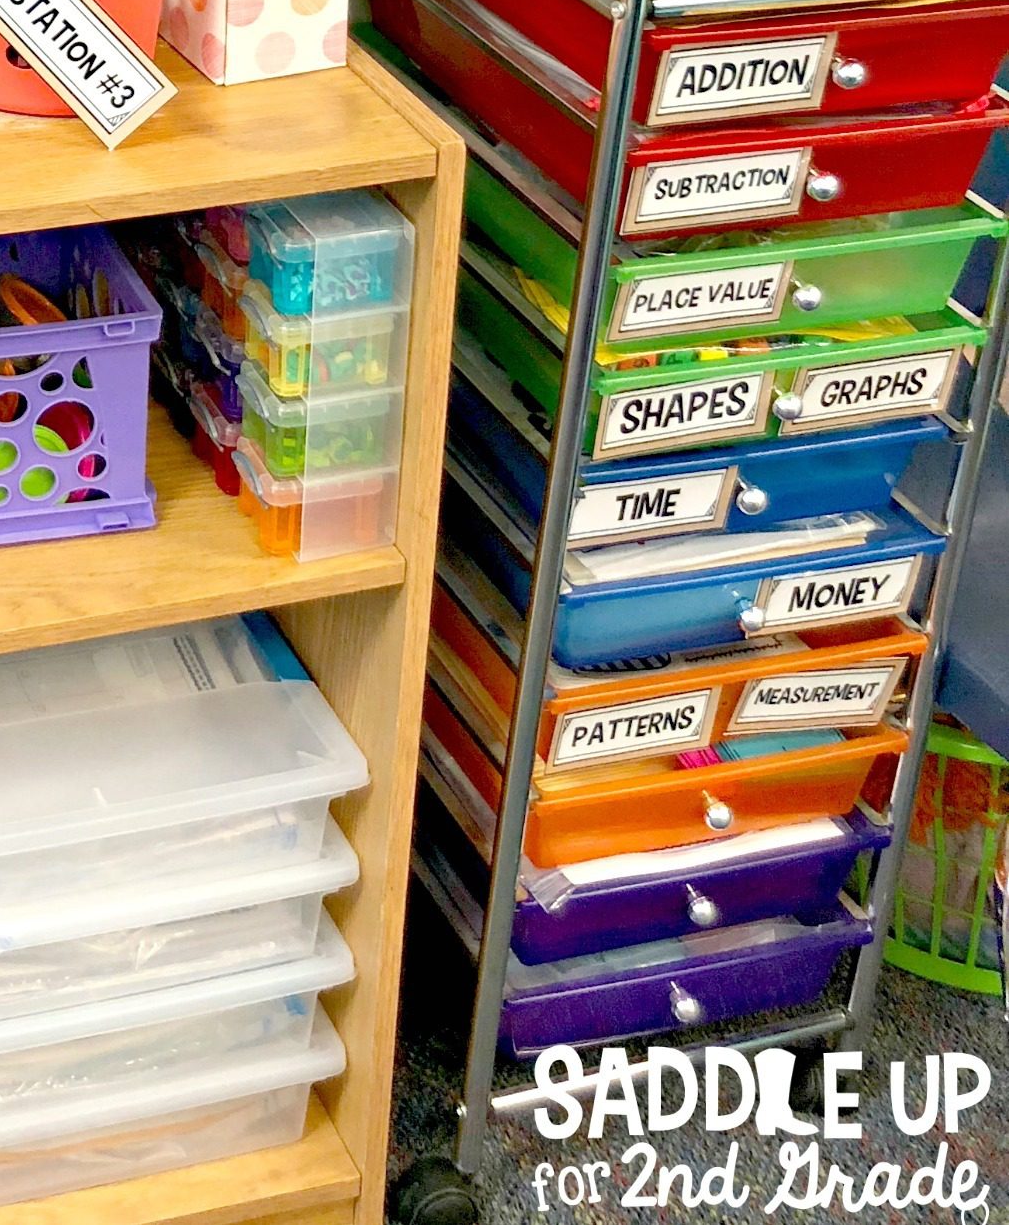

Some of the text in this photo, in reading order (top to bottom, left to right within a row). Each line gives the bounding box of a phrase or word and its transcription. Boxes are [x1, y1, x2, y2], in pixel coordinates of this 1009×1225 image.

[96, 73, 135, 108] #3
[676, 54, 809, 98] ADDITION
[654, 165, 790, 201] SUBTRACTION
[633, 277, 774, 314] PLACE VALUE
[820, 367, 928, 408] GRAPHS
[619, 381, 750, 435] SHAPES
[616, 488, 682, 521] TIME
[788, 574, 891, 613] MONEY
[753, 681, 880, 707] MEASUREMENT
[571, 705, 696, 748] PATTERNS
